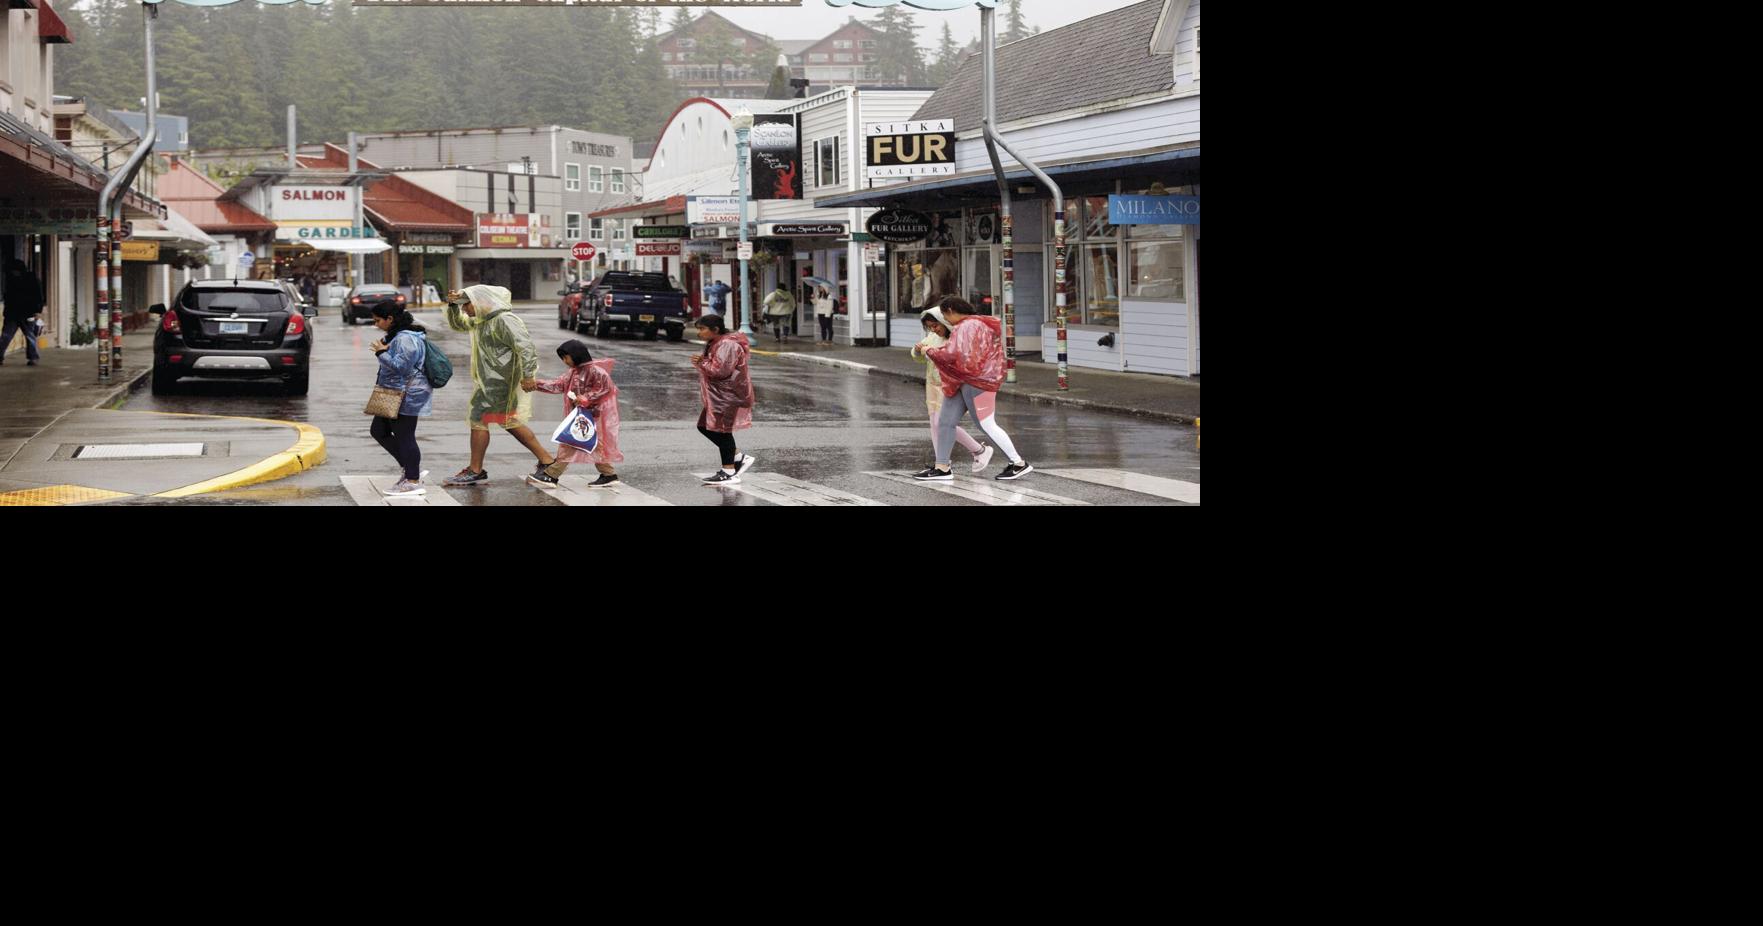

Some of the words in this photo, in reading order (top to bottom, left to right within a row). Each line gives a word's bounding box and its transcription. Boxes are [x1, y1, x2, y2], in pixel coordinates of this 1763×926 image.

[875, 122, 945, 134] SITKA
[873, 134, 947, 164] FUR
[875, 167, 949, 176] GALLERY
[282, 190, 346, 200] SALMON
[1116, 200, 1200, 215] MILANO
[703, 215, 741, 223] SALMON
[298, 227, 375, 238] GARDEN
[777, 225, 797, 233] Arctic
[797, 226, 817, 234] Spirit
[817, 225, 841, 233] Gallery
[871, 224, 889, 232] FUR
[890, 224, 928, 232] GALLERY
[573, 247, 595, 256] STOP
